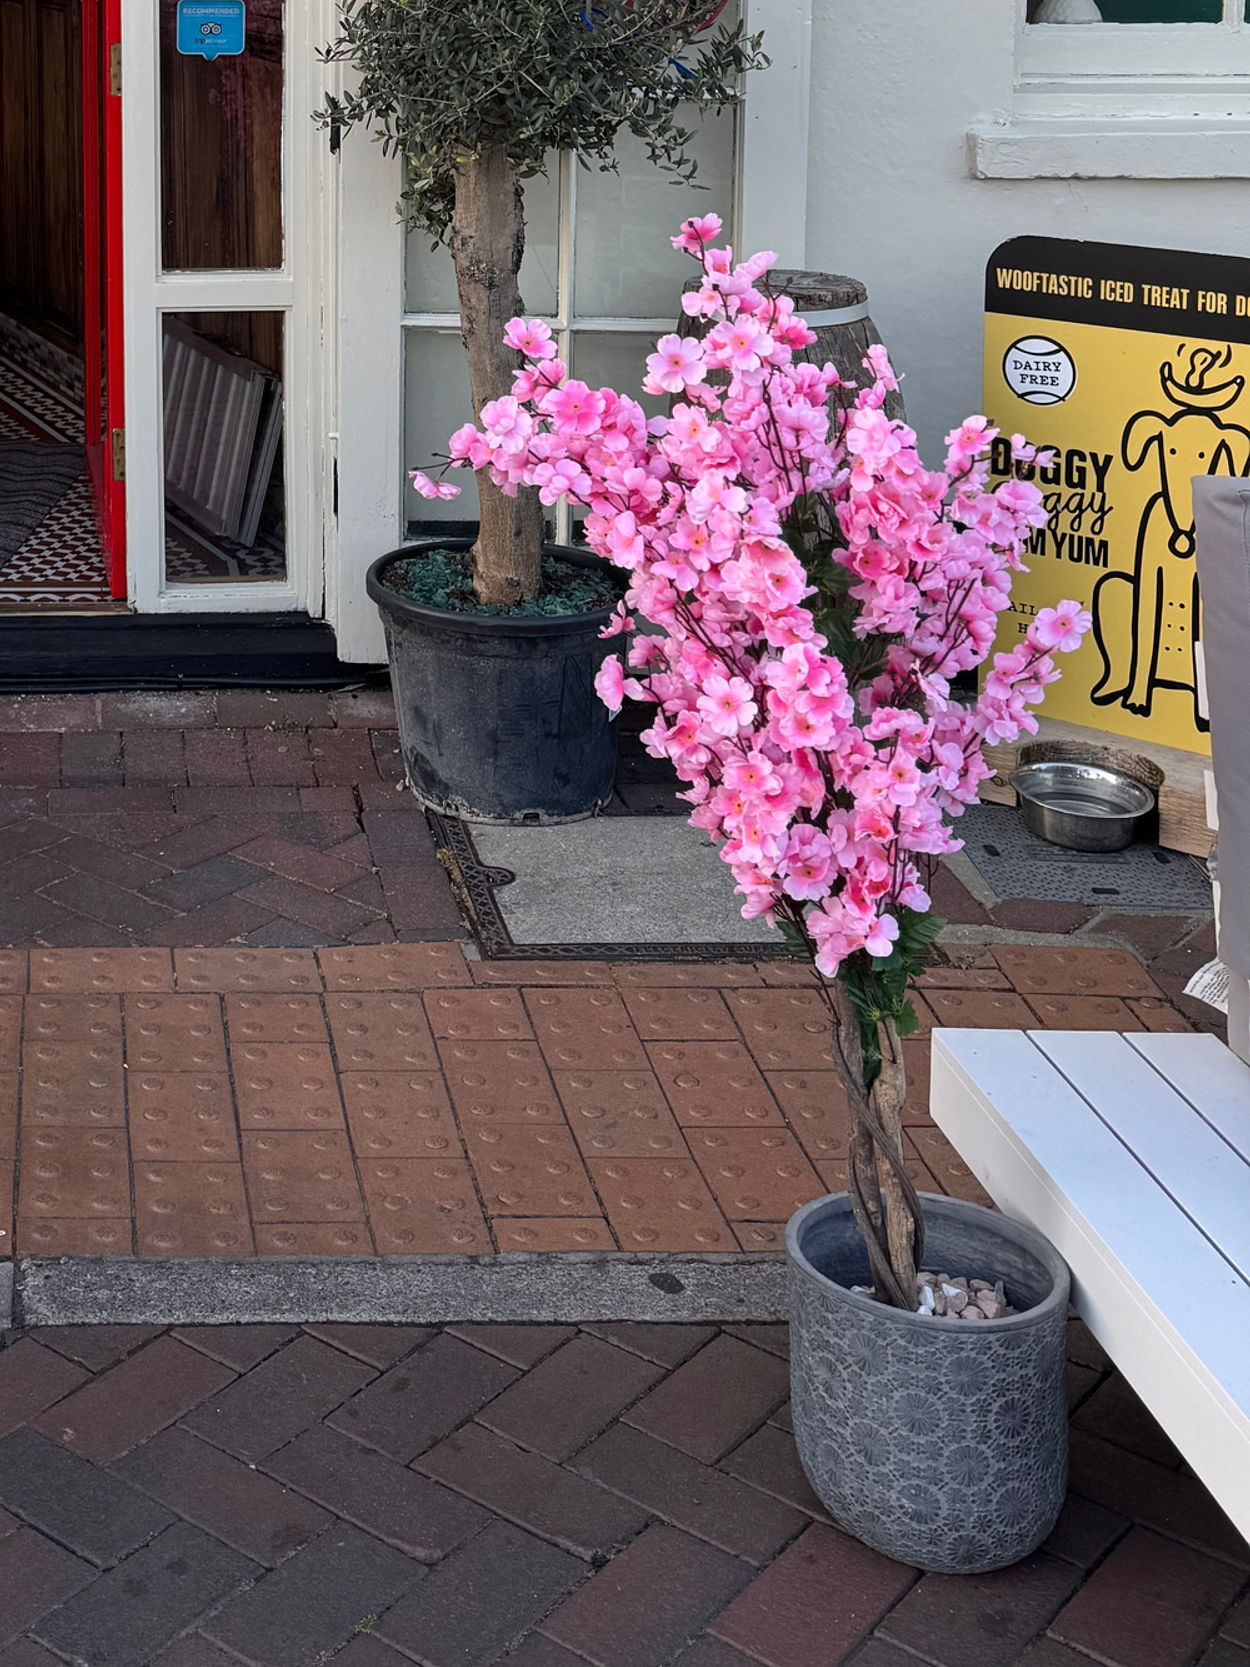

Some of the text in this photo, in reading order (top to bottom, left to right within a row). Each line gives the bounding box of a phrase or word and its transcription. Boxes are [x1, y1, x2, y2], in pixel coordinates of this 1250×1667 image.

[996, 267, 1250, 318] WOOFTASTIC ICED TREAT FOR D
[1013, 360, 1062, 373] DAIRY
[1019, 373, 1060, 387] FREE
[1049, 527, 1109, 569] YUM
